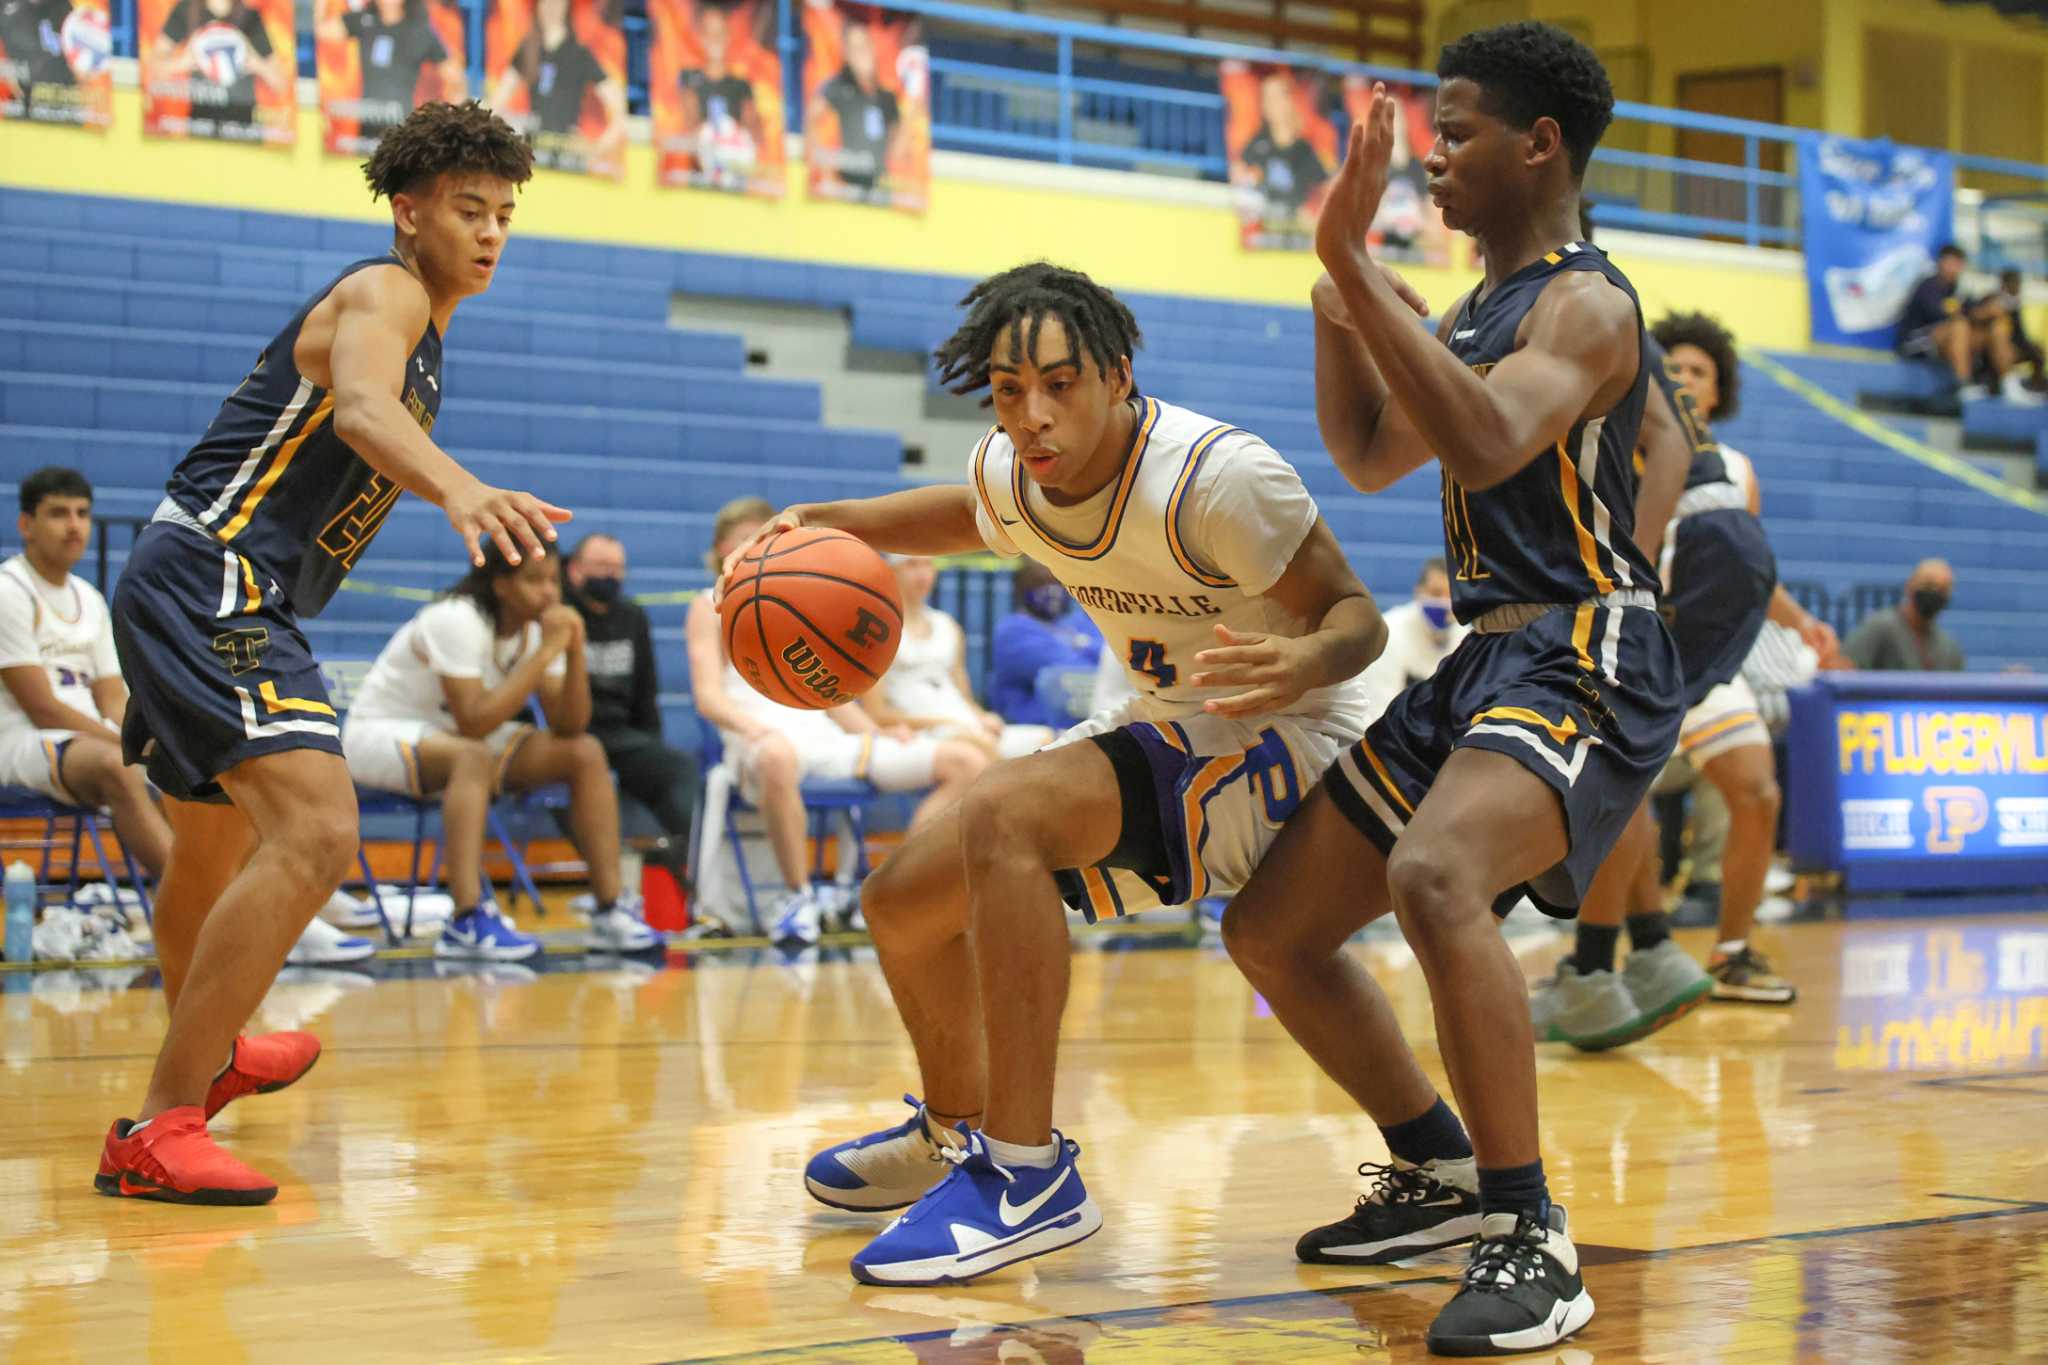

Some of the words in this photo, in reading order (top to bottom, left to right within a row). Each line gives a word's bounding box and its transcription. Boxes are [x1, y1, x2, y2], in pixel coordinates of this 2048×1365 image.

[848, 607, 891, 649] P
[1127, 636, 1178, 689] 4
[1837, 711, 2048, 775] PFLUGERVIL
[1924, 786, 1989, 855] P
